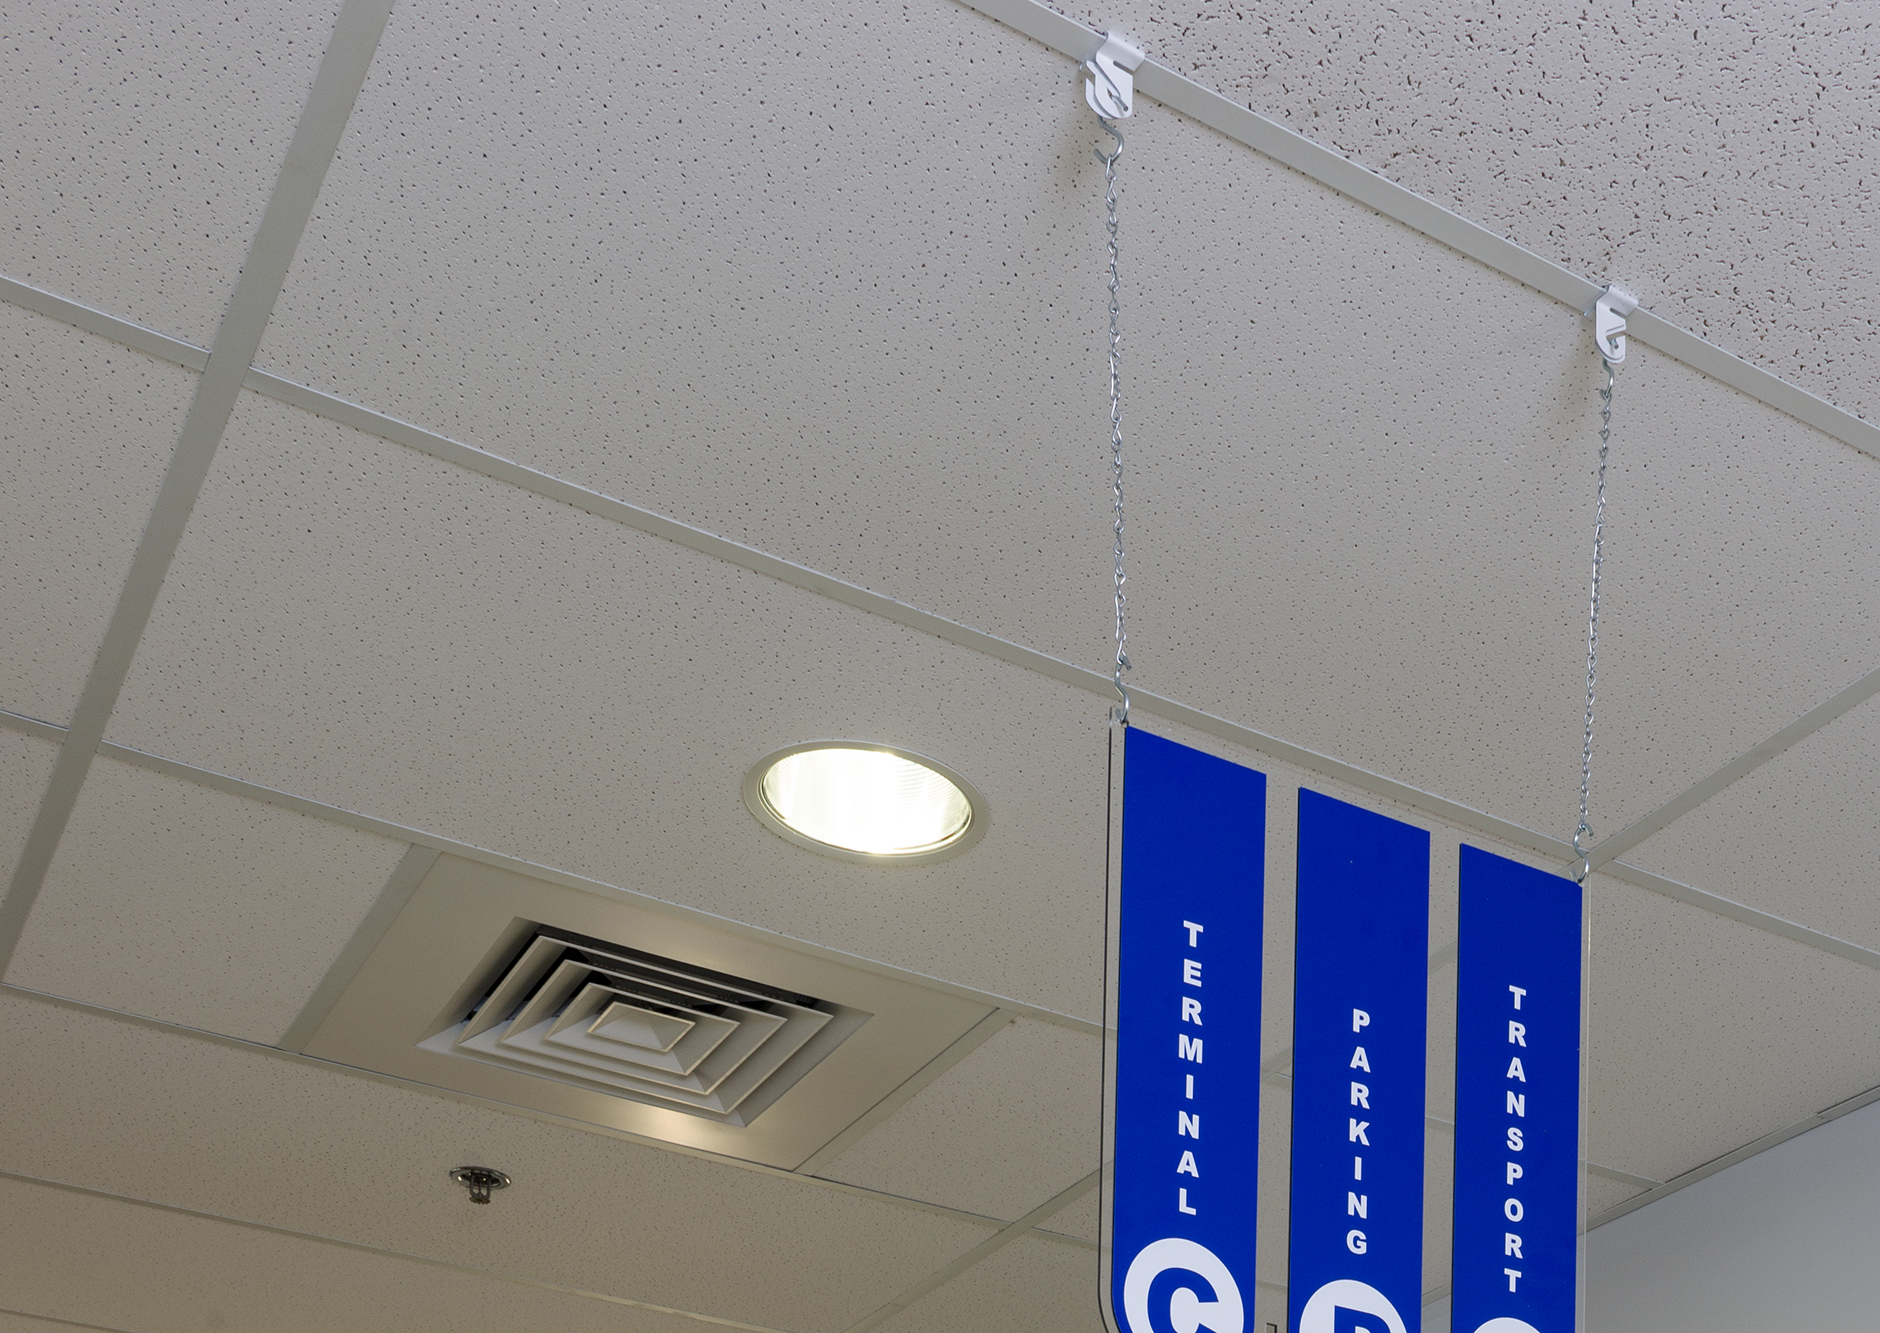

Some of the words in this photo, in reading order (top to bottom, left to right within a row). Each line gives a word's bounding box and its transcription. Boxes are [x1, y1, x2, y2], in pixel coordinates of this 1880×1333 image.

[1176, 919, 1204, 1216] TERMINAL
[1346, 1008, 1371, 1255] PARKING
[1503, 984, 1527, 1293] TRANSPORT
